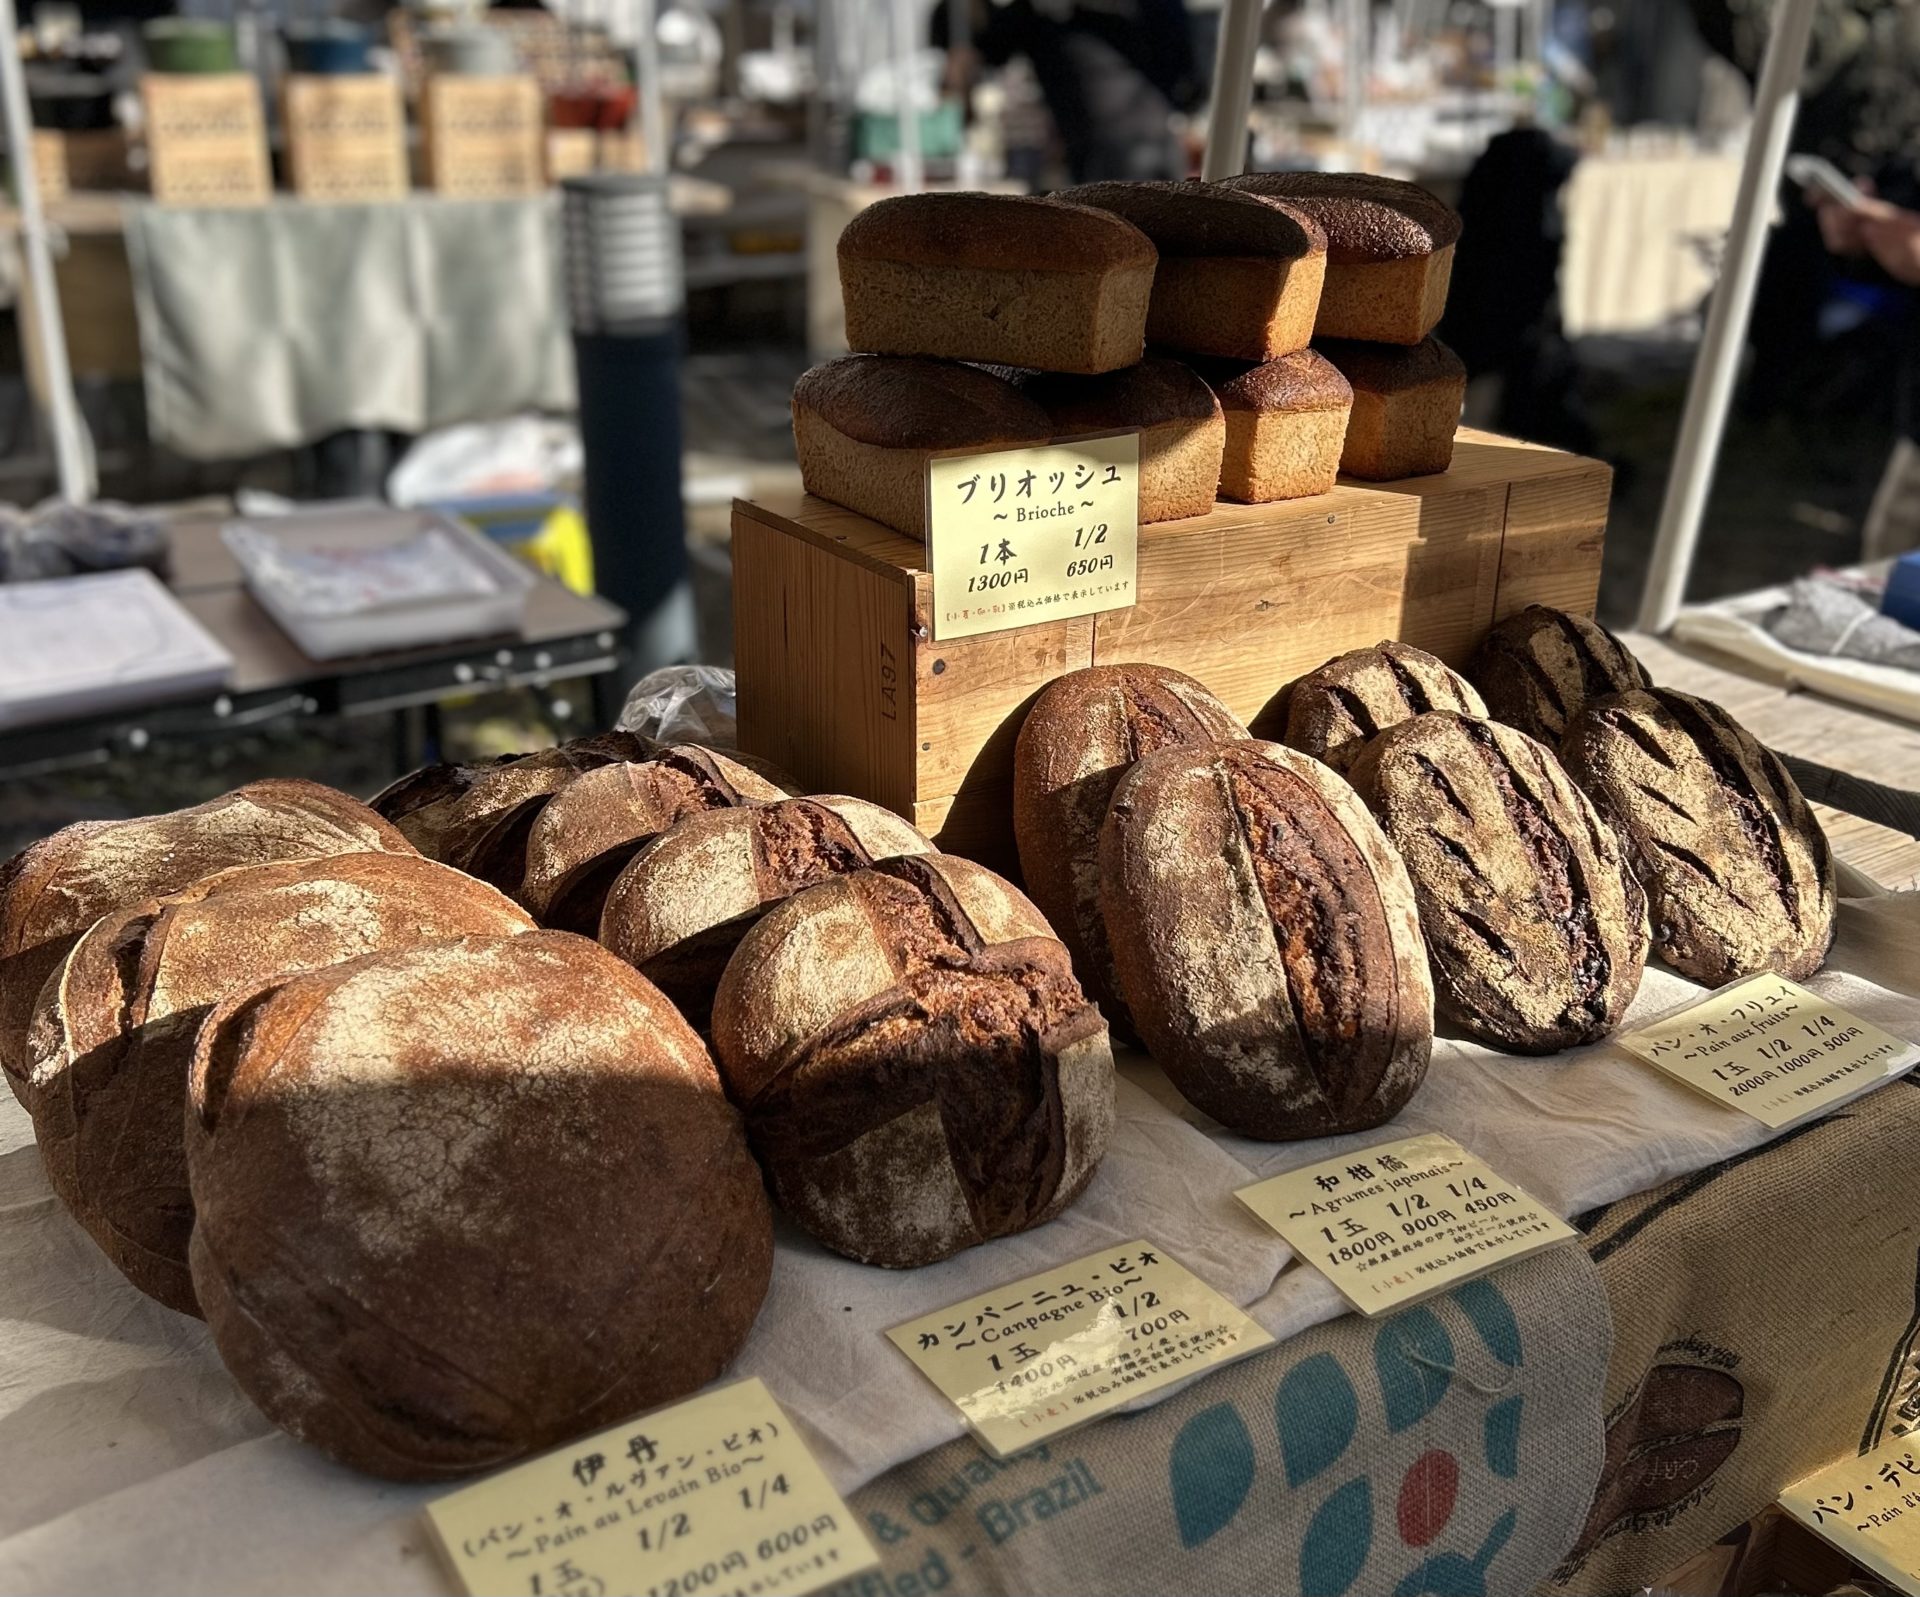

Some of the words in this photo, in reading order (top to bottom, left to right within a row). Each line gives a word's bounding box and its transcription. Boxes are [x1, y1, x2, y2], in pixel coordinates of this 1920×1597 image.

[957, 464, 1121, 504] ブリオッシュ
[1017, 502, 1075, 522] Brioche
[980, 538, 1017, 565] 1本
[1075, 523, 1108, 549] 1/2
[968, 568, 1028, 592] 1300円
[1066, 555, 1113, 577] 650円
[1651, 986, 1796, 1056] パン・オ・フリュイ
[1731, 1030, 1752, 1043] aux
[1712, 1061, 1751, 1081] 1玉
[1757, 1039, 1792, 1059] 1/2
[1801, 1015, 1839, 1037] 1/4
[1729, 1071, 1779, 1096] 2000円
[1776, 1048, 1824, 1074] 1000円
[1822, 1027, 1864, 1051] 500円
[1315, 1155, 1408, 1192] 和柑橘
[1320, 1218, 1368, 1243] 1玉
[1386, 1194, 1430, 1217] 1/2
[1445, 1177, 1488, 1197] 1/4
[1326, 1231, 1395, 1266] 1800円
[1401, 1210, 1457, 1236] 900円
[1465, 1192, 1517, 1214] 450円
[917, 1252, 1159, 1351] カンパーニュ・ビオ
[1119, 1309, 1190, 1342] 700円
[987, 1342, 1041, 1371] 1玉
[1110, 1291, 1161, 1320] 1/2
[572, 1434, 658, 1487] 伊丹
[594, 1511, 622, 1530] au
[625, 1479, 701, 1517] Levain
[637, 1512, 692, 1552] 1/2
[738, 1473, 790, 1510] 1/4
[976, 1456, 1104, 1546] Brazil
[756, 1514, 838, 1562] 600円
[868, 1511, 908, 1544] &
